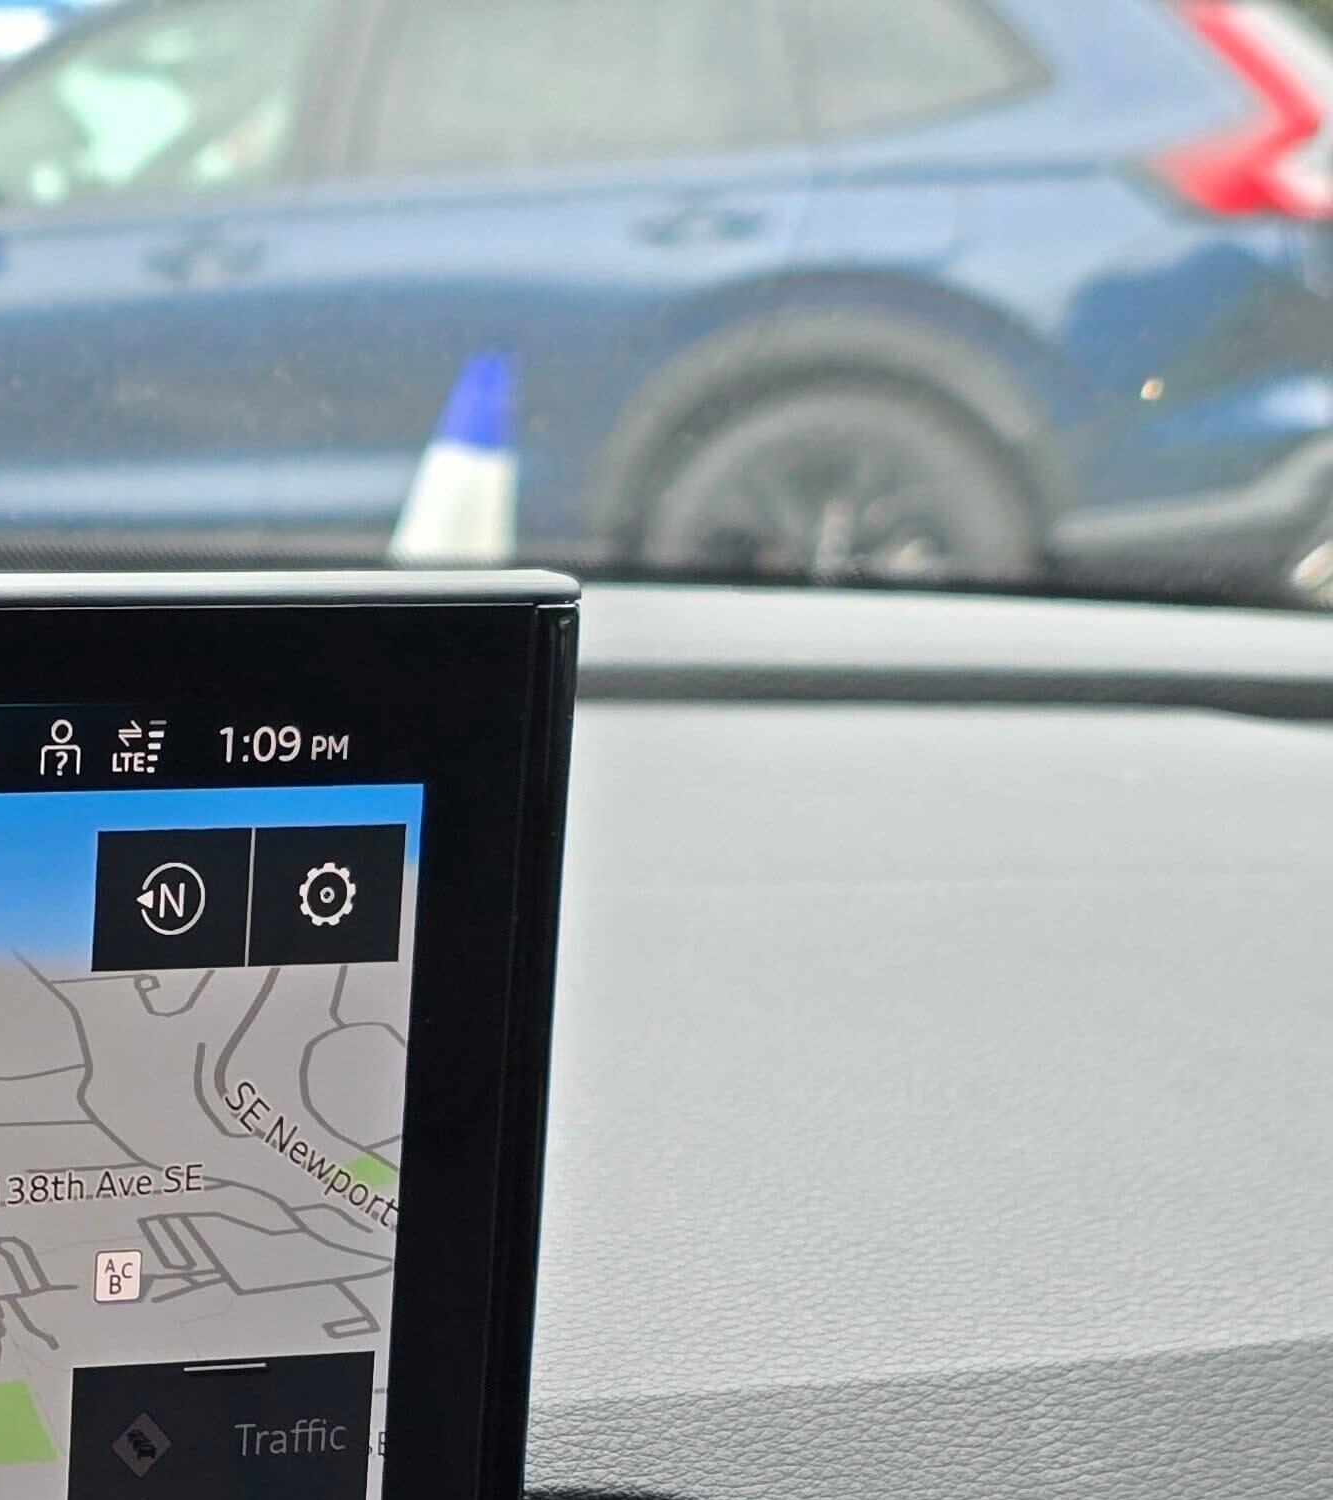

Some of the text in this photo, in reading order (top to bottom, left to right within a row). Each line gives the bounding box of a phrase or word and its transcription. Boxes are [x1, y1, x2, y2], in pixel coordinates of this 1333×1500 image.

[111, 752, 146, 773] LTE
[219, 725, 350, 764] 1:09 PM
[158, 882, 186, 919] N
[224, 1080, 400, 1227] SE Newport
[94, 1169, 153, 1199] Ave
[163, 1163, 204, 1193] SE
[234, 1418, 347, 1457] Traffic
